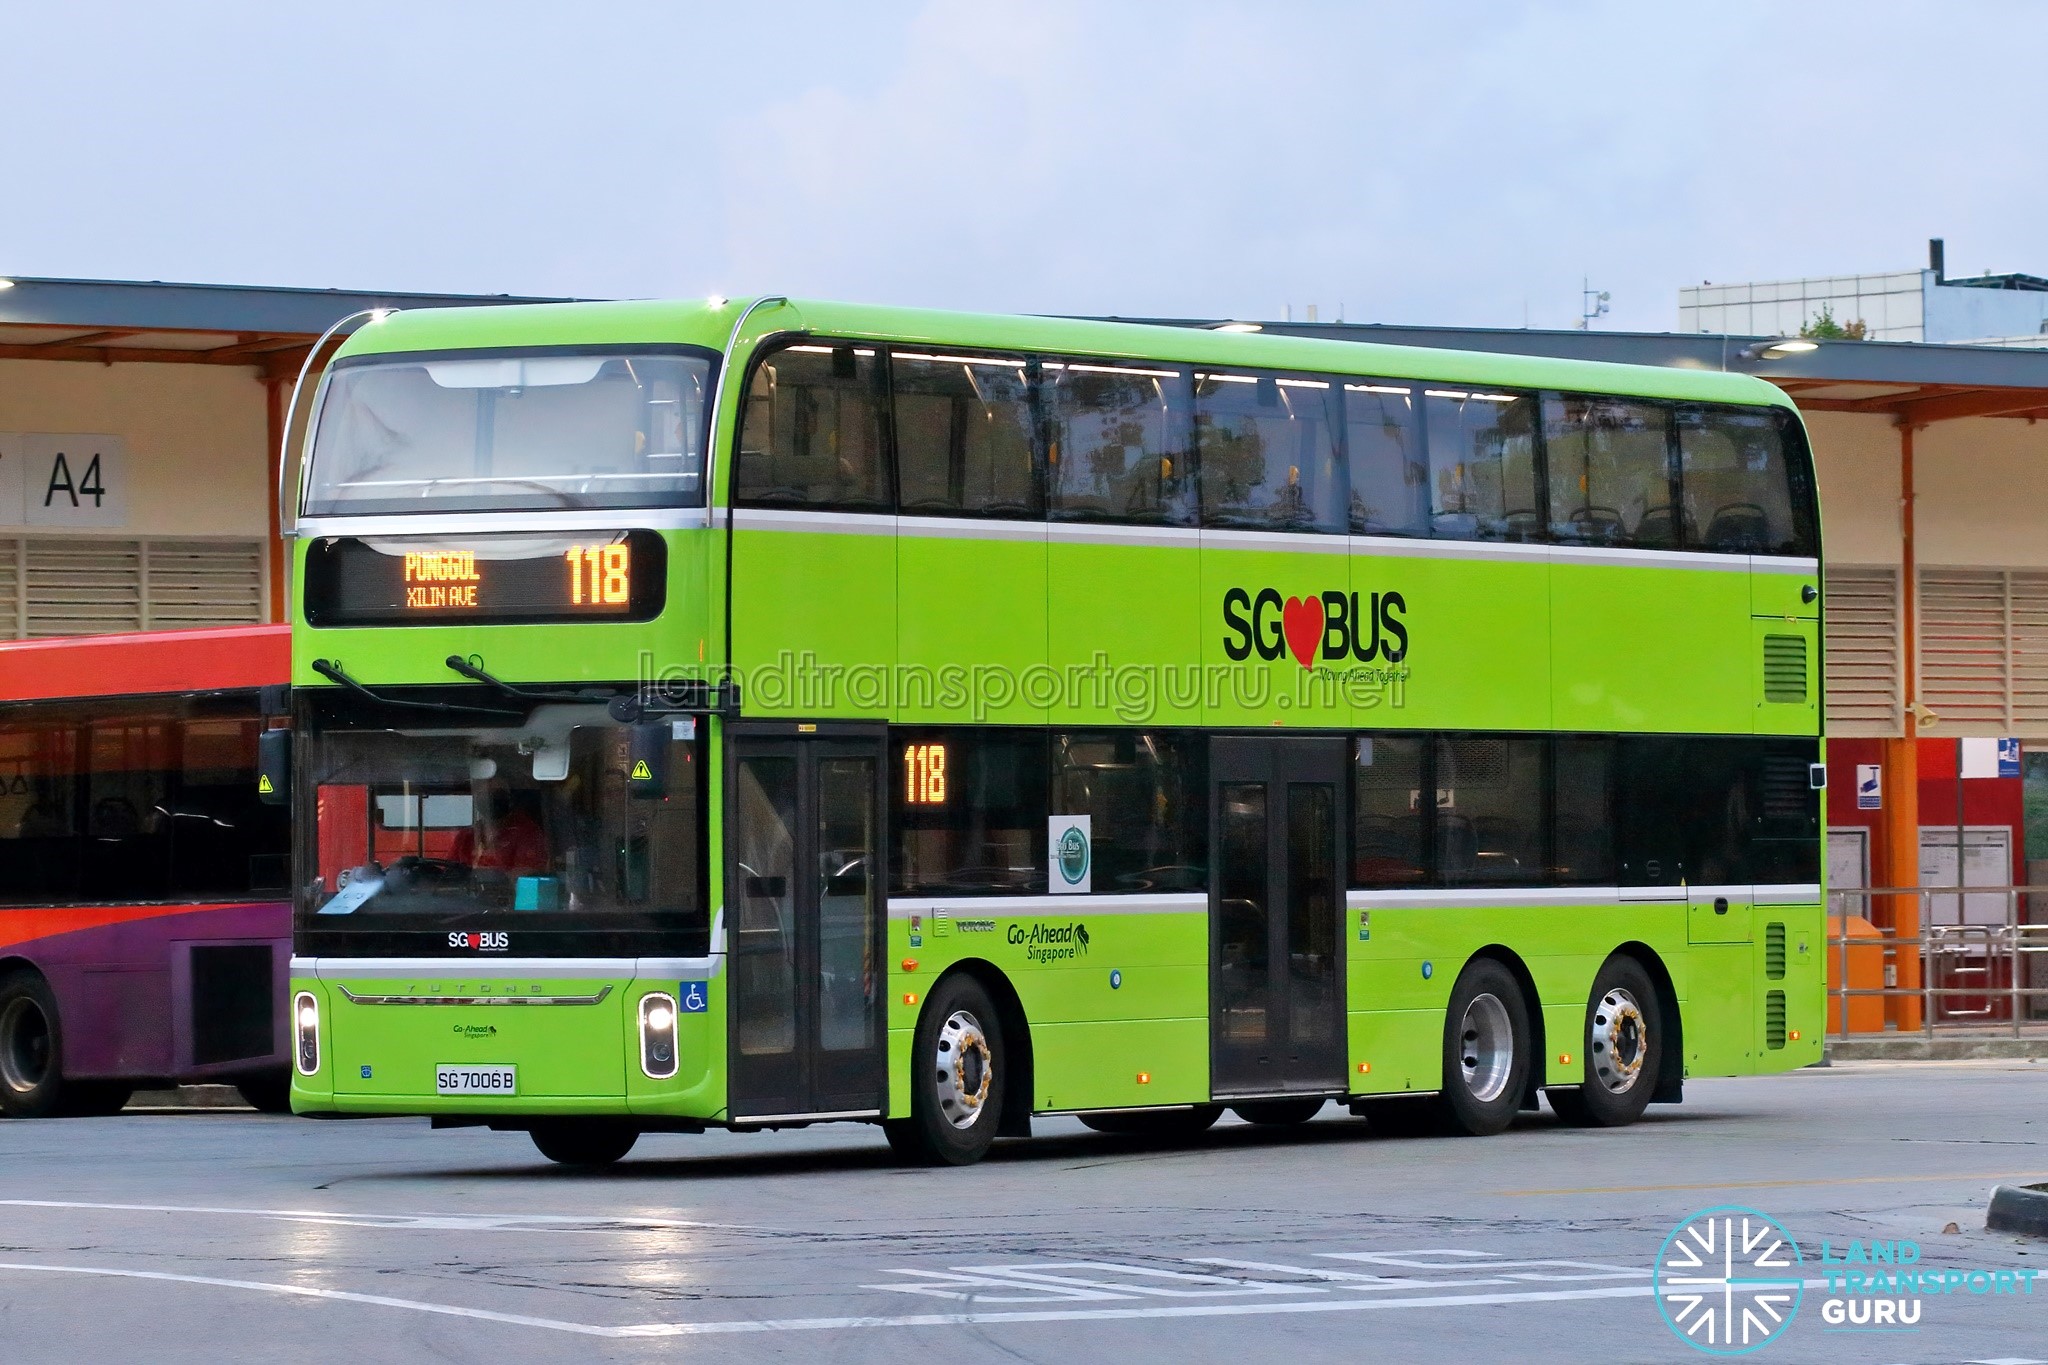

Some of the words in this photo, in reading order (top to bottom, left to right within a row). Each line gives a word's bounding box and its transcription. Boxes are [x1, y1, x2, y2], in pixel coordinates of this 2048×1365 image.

[44, 452, 106, 508] A4
[405, 551, 481, 582] PUNGGOL
[566, 544, 628, 604] 118
[407, 587, 446, 607] XILIN
[449, 586, 478, 606] AVE
[1321, 590, 1409, 663] BUS
[904, 745, 945, 802] 118
[479, 932, 509, 947] BUS
[1007, 922, 1073, 945] Go-Ahead
[1027, 945, 1075, 964] Singapore
[453, 1024, 488, 1033] Go-Ahead
